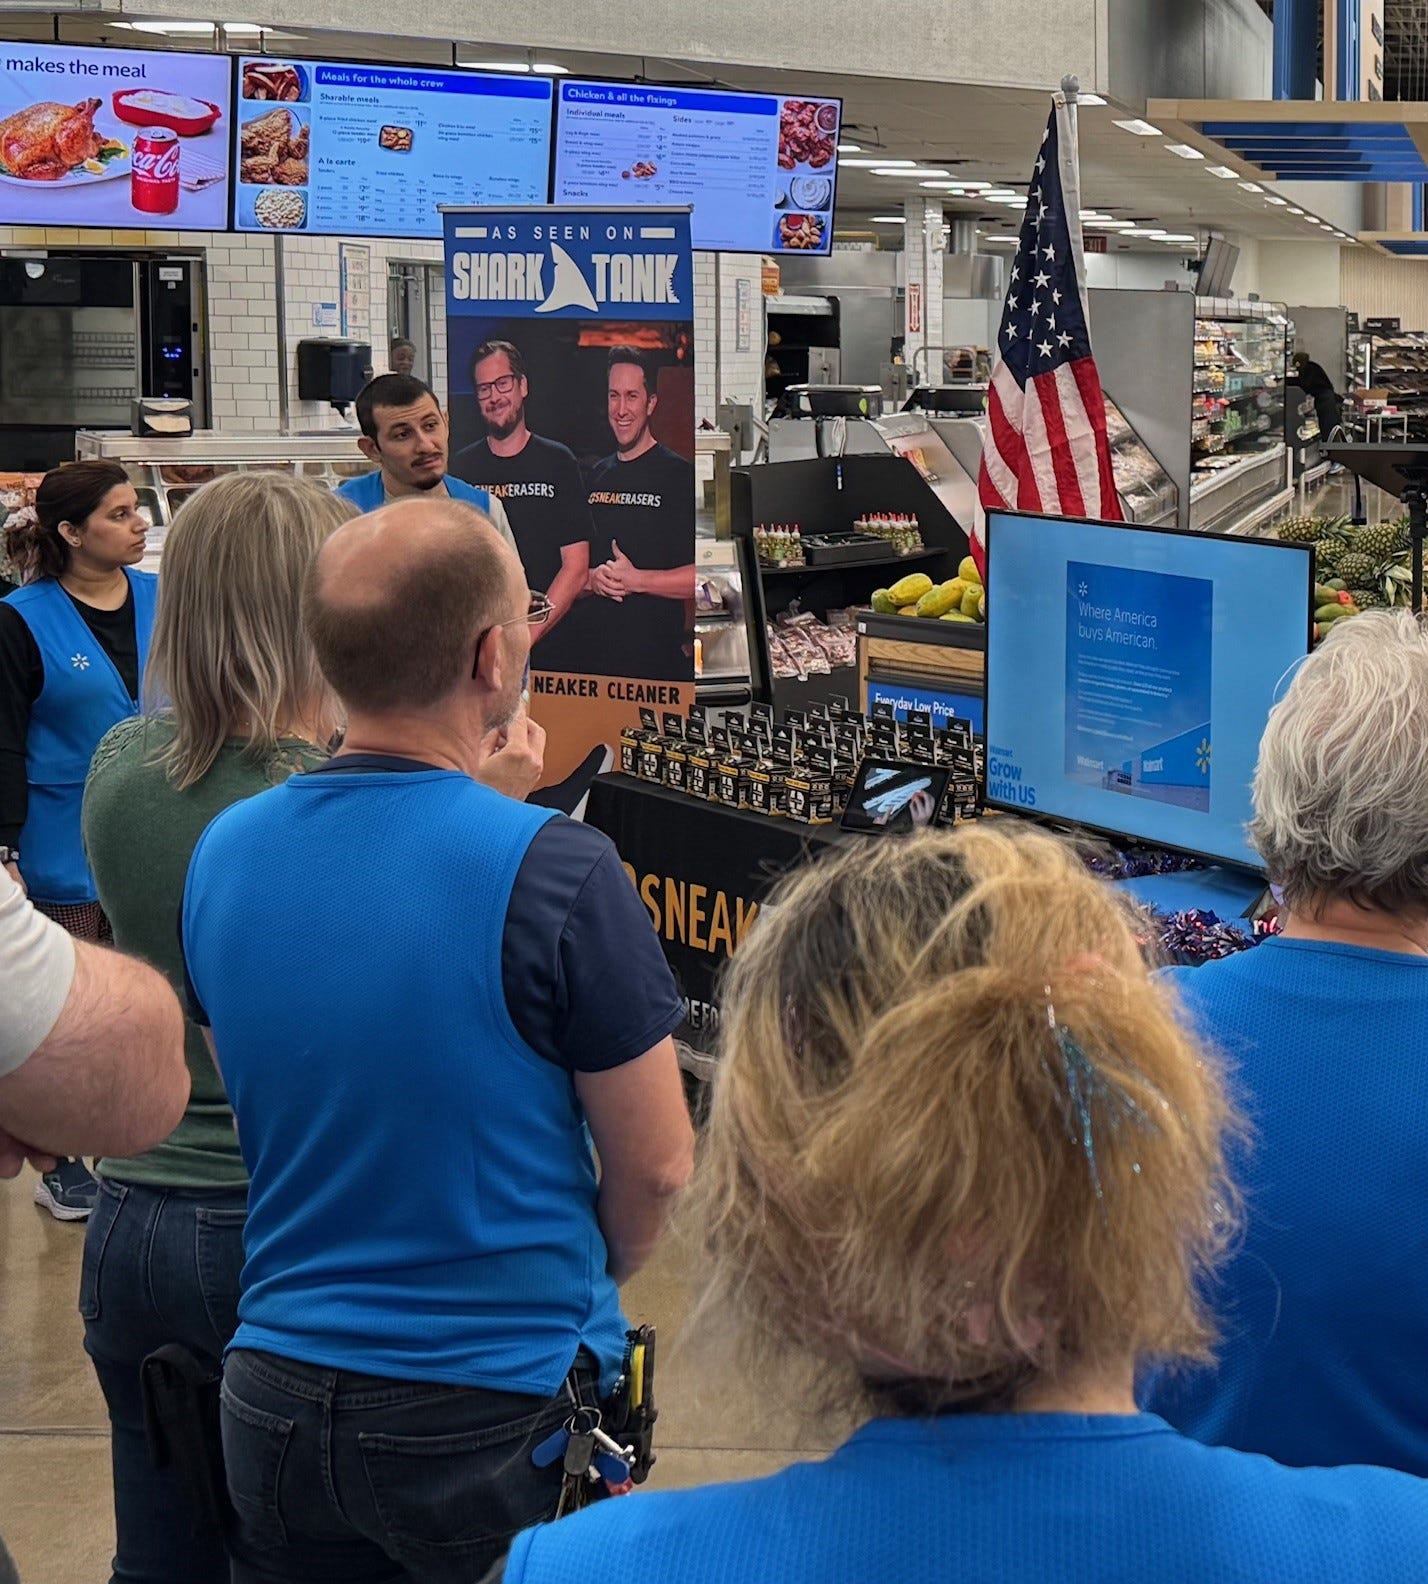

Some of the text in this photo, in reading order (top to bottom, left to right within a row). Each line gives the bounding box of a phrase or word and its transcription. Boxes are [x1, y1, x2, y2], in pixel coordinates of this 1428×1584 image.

[6, 56, 147, 78] makes the meal
[321, 71, 444, 88] Meals for the whole crew
[568, 88, 677, 107] Chicken & all the fixings
[492, 226, 633, 240] AS SEEN ON
[453, 252, 680, 303] SHARK TANK
[1078, 601, 1157, 628] Where America
[1078, 622, 1158, 650] buys American.
[534, 675, 680, 705] NEAKER CLEANER
[914, 698, 931, 713] Low
[933, 701, 955, 717] Price
[989, 757, 1022, 781] Grow
[989, 780, 1036, 805] with US
